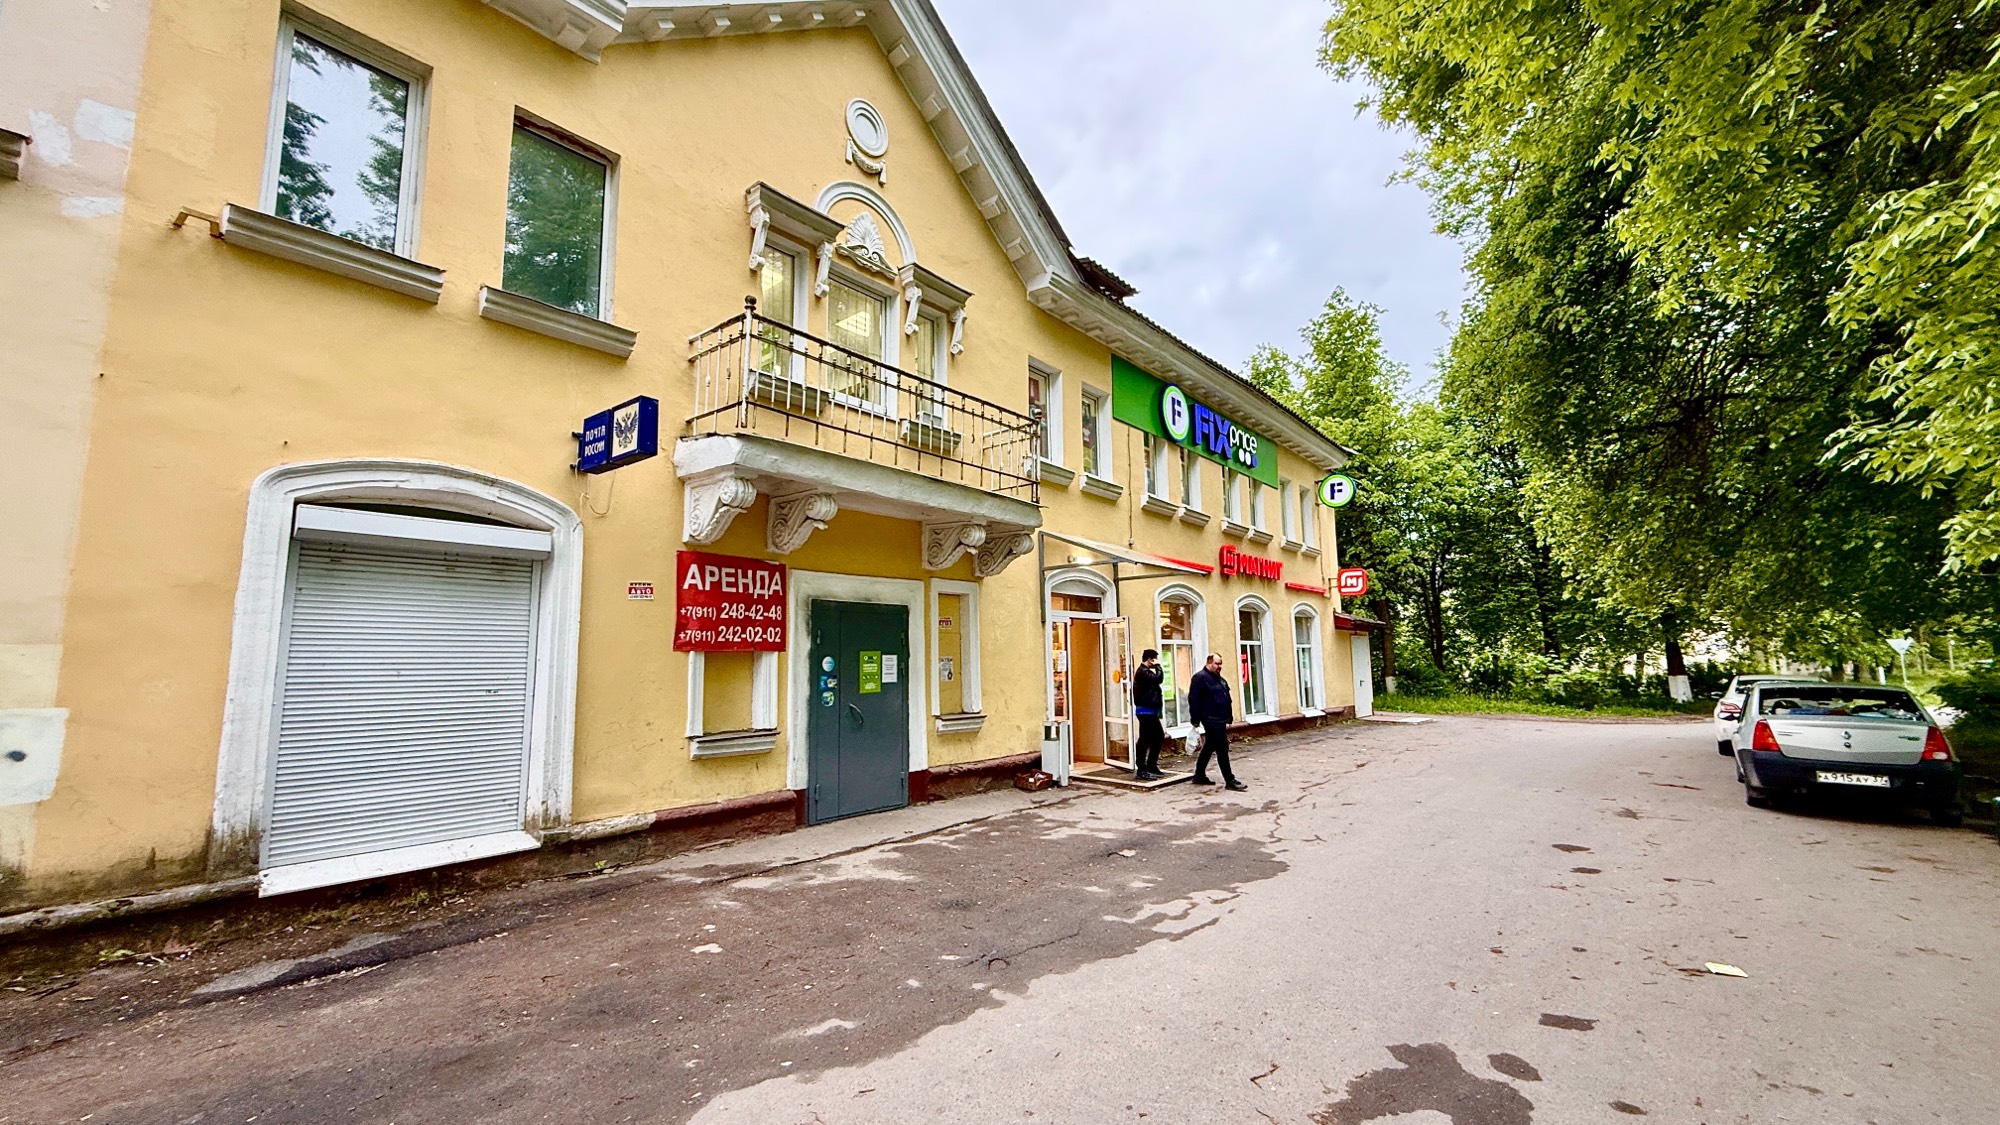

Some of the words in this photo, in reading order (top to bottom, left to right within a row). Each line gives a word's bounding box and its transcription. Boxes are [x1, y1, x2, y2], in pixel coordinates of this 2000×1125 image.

[585, 425, 606, 442] ПОЧТА
[1229, 425, 1258, 454] price
[584, 440, 605, 457] РОССИИ
[1239, 553, 1284, 581] МАГНИТ
[683, 563, 783, 600] АРЕНДА
[680, 605, 717, 621] +7(911)
[720, 602, 783, 621] 248-42-48
[678, 630, 716, 645] +7(911)
[717, 625, 782, 643] 242-02-02
